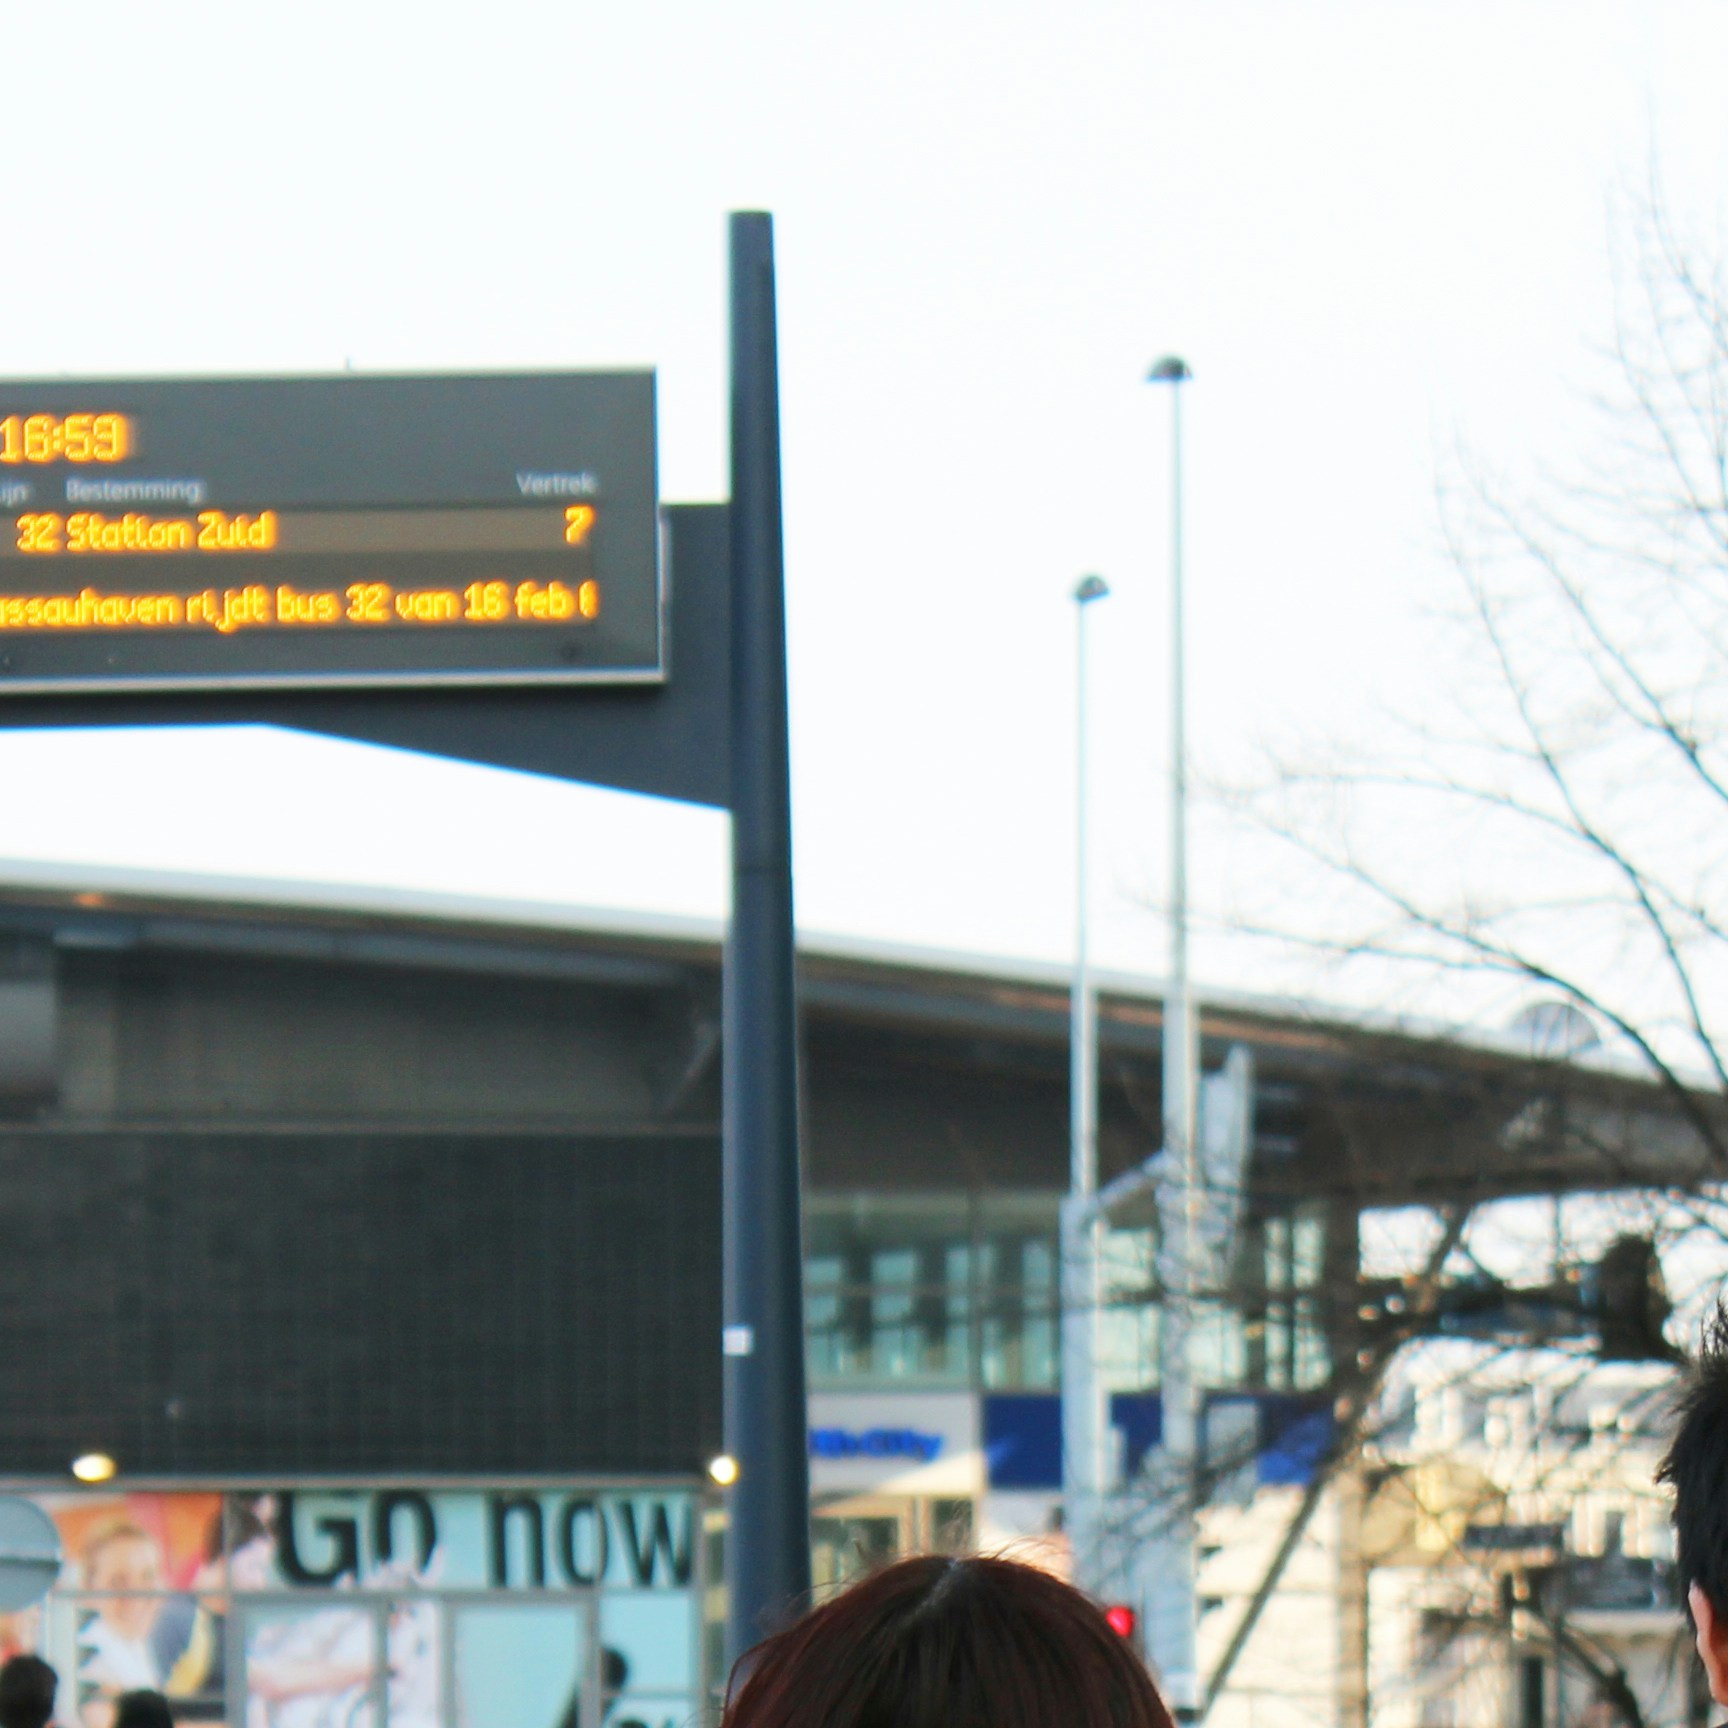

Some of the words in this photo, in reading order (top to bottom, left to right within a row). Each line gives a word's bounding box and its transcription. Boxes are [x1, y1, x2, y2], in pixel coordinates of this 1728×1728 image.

[0, 414, 127, 463] 16:59
[65, 476, 206, 505] Bestemming
[516, 470, 597, 497] Vertrek
[17, 513, 61, 550] 32
[66, 512, 193, 550] Station
[197, 510, 276, 550] Zuid
[564, 504, 596, 545] 7
[186, 584, 270, 633] rijdt
[276, 584, 339, 623] bus
[345, 581, 391, 623] 32
[395, 591, 460, 622] van
[464, 581, 510, 620] 16
[515, 581, 573, 620] feb
[276, 1491, 436, 1588] Go
[486, 1491, 692, 1588] now
